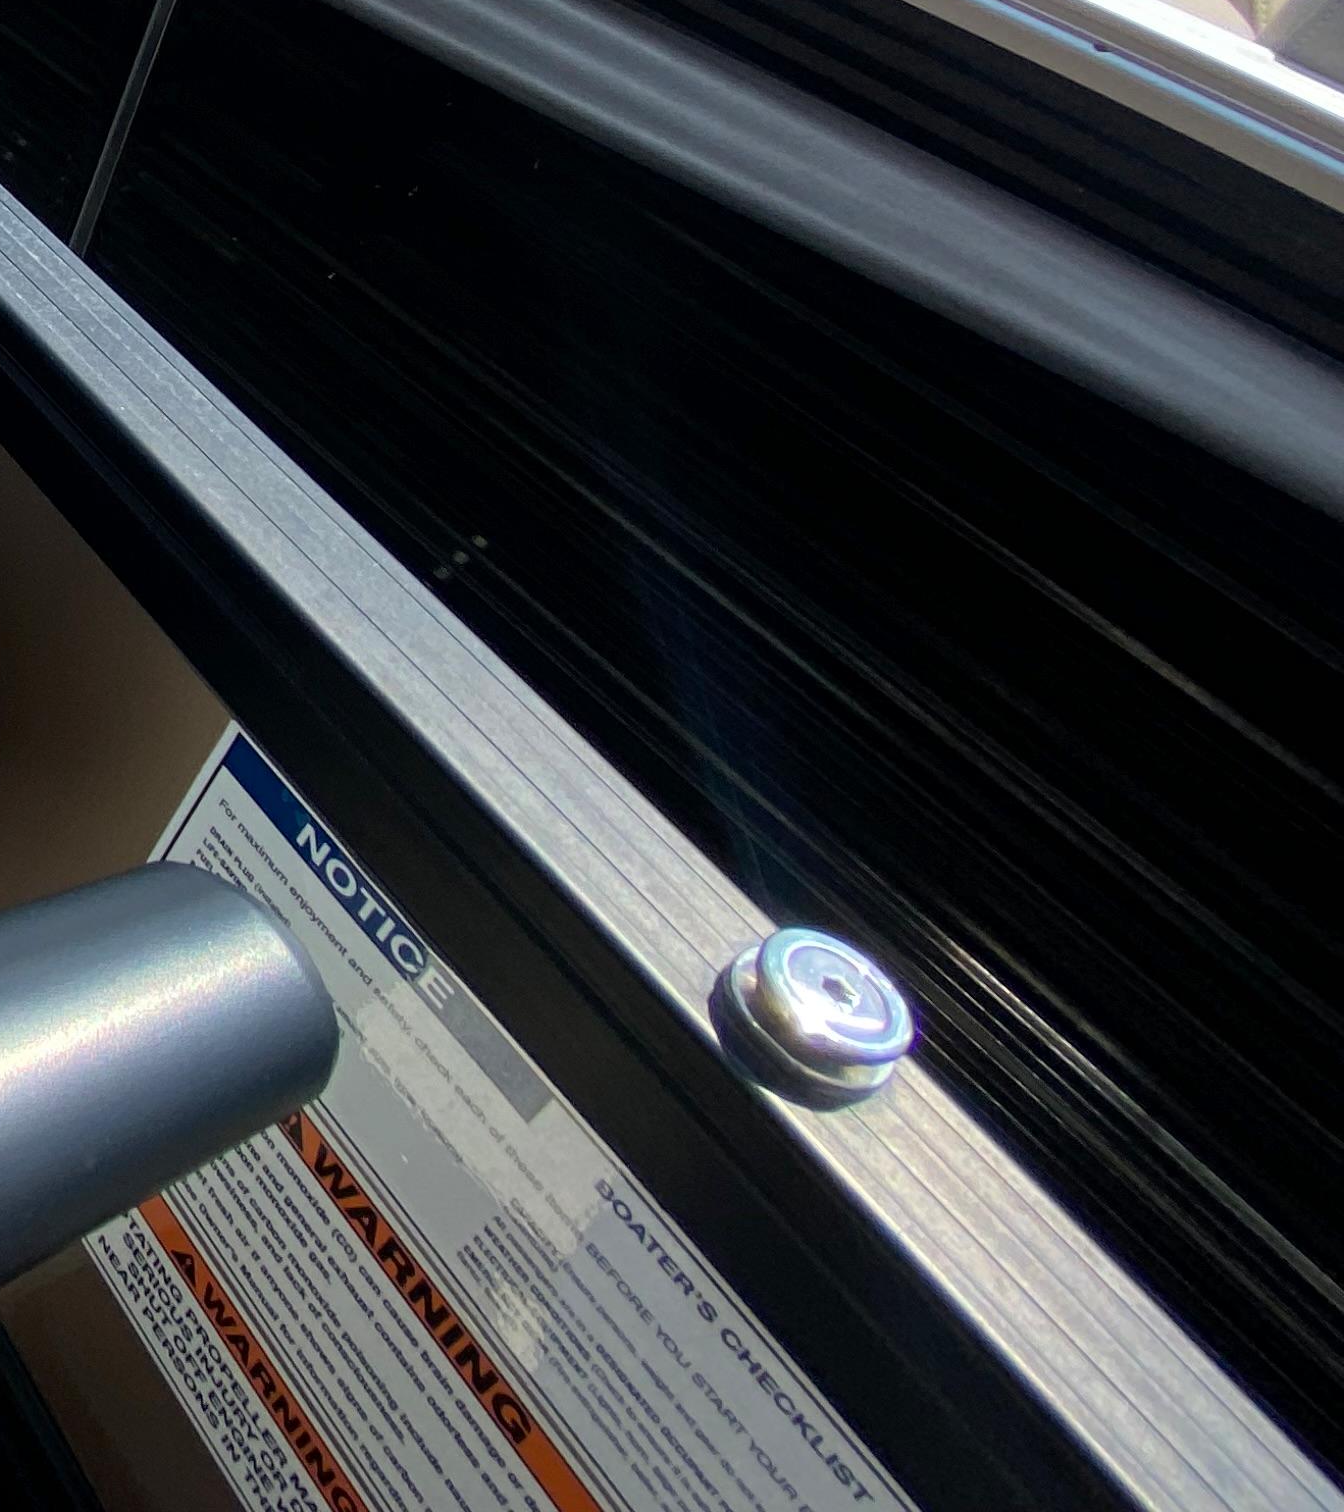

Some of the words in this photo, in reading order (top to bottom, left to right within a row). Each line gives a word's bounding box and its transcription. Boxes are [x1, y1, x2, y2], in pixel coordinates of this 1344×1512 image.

[217, 796, 238, 824] For
[236, 819, 290, 887] maximum
[287, 883, 348, 959] enjoyment
[347, 954, 372, 987] and
[412, 1033, 452, 1083] check
[453, 1082, 488, 1127] each
[295, 820, 455, 1013] NOTICE
[96, 1233, 141, 1304] NEAR
[141, 1303, 220, 1430] PERSONS
[220, 1432, 241, 1466] IN
[124, 1214, 184, 1307] TATING
[184, 1306, 289, 1469] PROPELLER
[196, 1202, 240, 1264] Owner's
[238, 1262, 280, 1323] Manual
[278, 1320, 297, 1348] for
[206, 1185, 235, 1228] fresh
[234, 1226, 251, 1251] air
[258, 1263, 300, 1325] anyone
[298, 1321, 337, 1377] shows
[381, 1442, 425, 1506] carbon
[207, 1158, 260, 1235] owsiness,
[259, 1232, 283, 1266] and
[281, 1264, 308, 1302] lack
[307, 1300, 321, 1321] of
[235, 1177, 249, 1197] of
[248, 1194, 288, 1252] carbon
[286, 1249, 343, 1330] monoxide
[340, 1328, 400, 1413] poisoning
[399, 1411, 445, 1477] include
[254, 1171, 310, 1250] monoxide
[306, 1249, 333, 1287] gas.
[260, 1162, 284, 1195] and
[282, 1193, 327, 1256] general
[326, 1253, 374, 1322] exhaust
[373, 1317, 427, 1393] contains
[426, 1392, 482, 1471] odorless
[480, 1468, 508, 1508] and
[275, 1148, 332, 1227] monoxide
[330, 1225, 358, 1266] (CO)
[357, 1263, 382, 1298] can
[381, 1296, 420, 1349] cause
[419, 1347, 455, 1397] brain
[453, 1394, 507, 1471] damage
[506, 1468, 523, 1493] or
[307, 1141, 533, 1448] WARNING
[593, 1175, 718, 1328] BOATER'S
[717, 1322, 874, 1512] CHECKLIST
[121, 1230, 194, 1343] SERIOUS
[193, 1344, 259, 1446] INJURY
[258, 1447, 288, 1493] OR
[126, 1259, 172, 1331] SHUT
[171, 1333, 207, 1388] OFF
[206, 1388, 275, 1494] ENGINE
[197, 1280, 361, 1512] WARNING
[584, 1238, 654, 1325] BEFORE
[652, 1322, 692, 1373] YOU
[690, 1368, 746, 1438] START
[744, 1434, 799, 1503] YOUR
